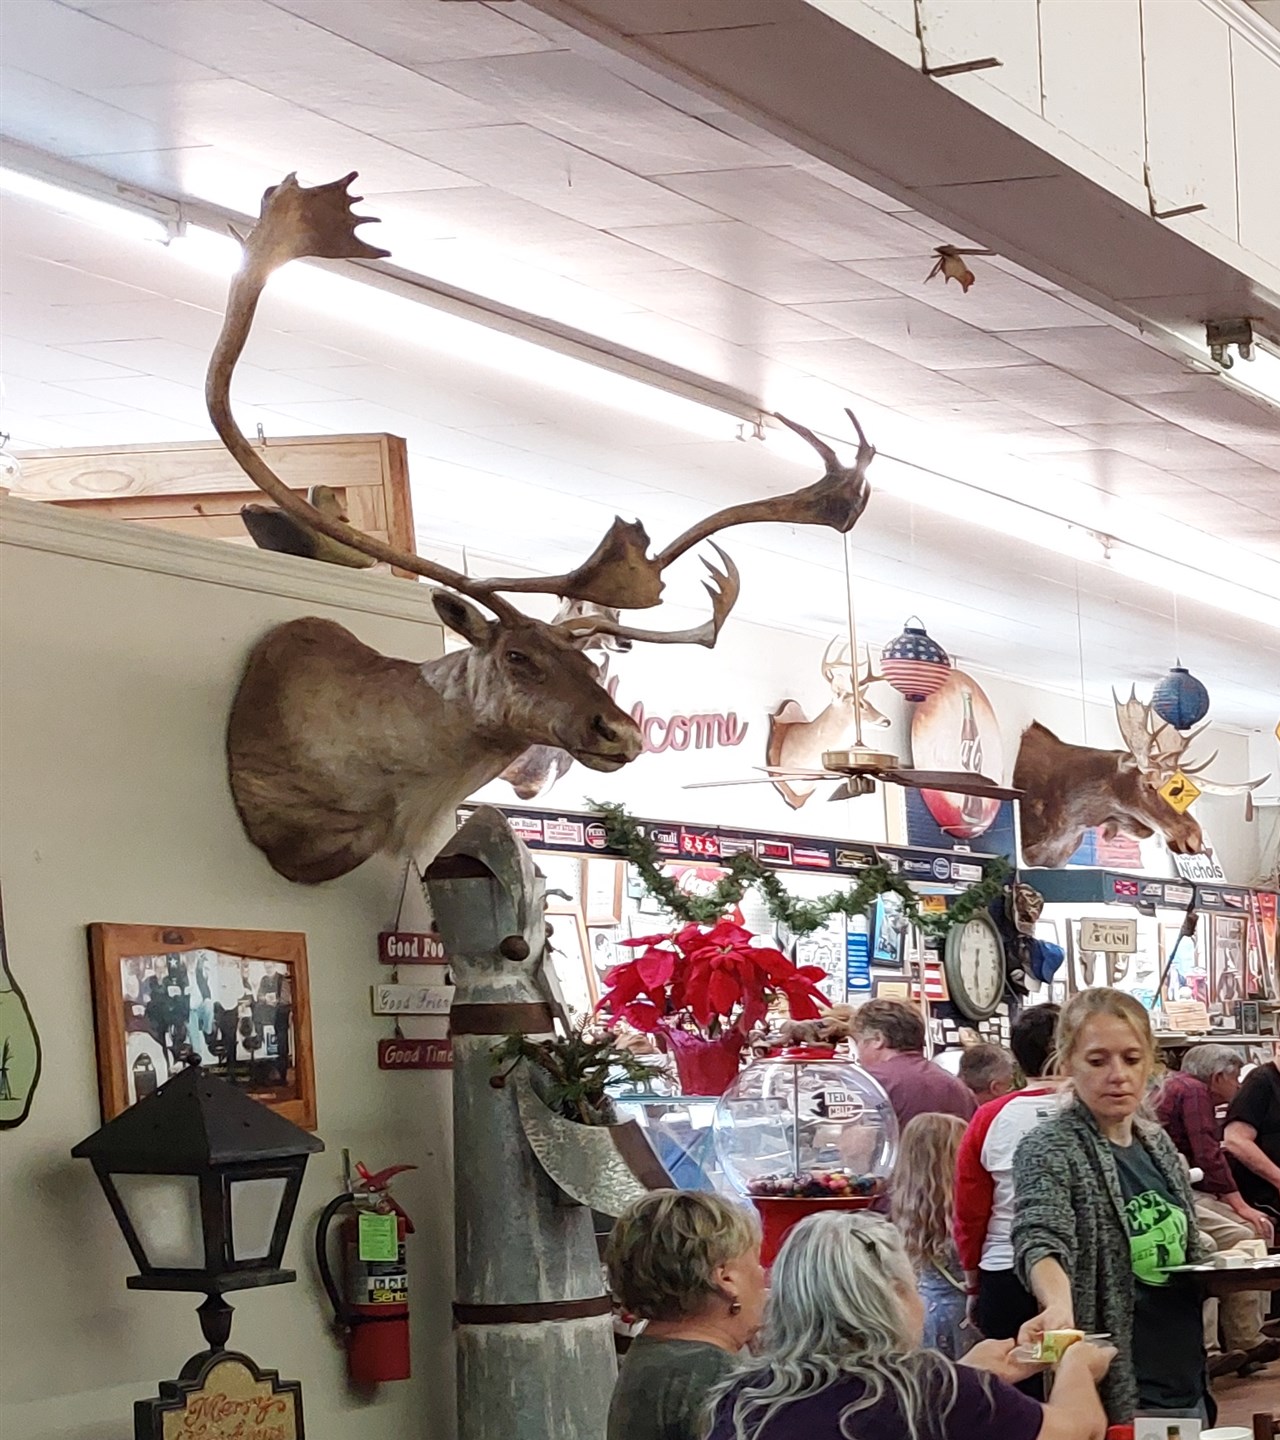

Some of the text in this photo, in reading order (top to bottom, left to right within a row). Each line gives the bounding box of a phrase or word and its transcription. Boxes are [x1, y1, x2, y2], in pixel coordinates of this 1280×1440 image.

[607, 675, 749, 753] lcome
[1179, 861, 1223, 879] Nichols
[387, 936, 445, 958] Good Foo
[379, 990, 410, 1010] Good
[384, 1044, 453, 1063] Good Time
[827, 1092, 845, 1103] TED
[184, 1393, 287, 1428] Merry
